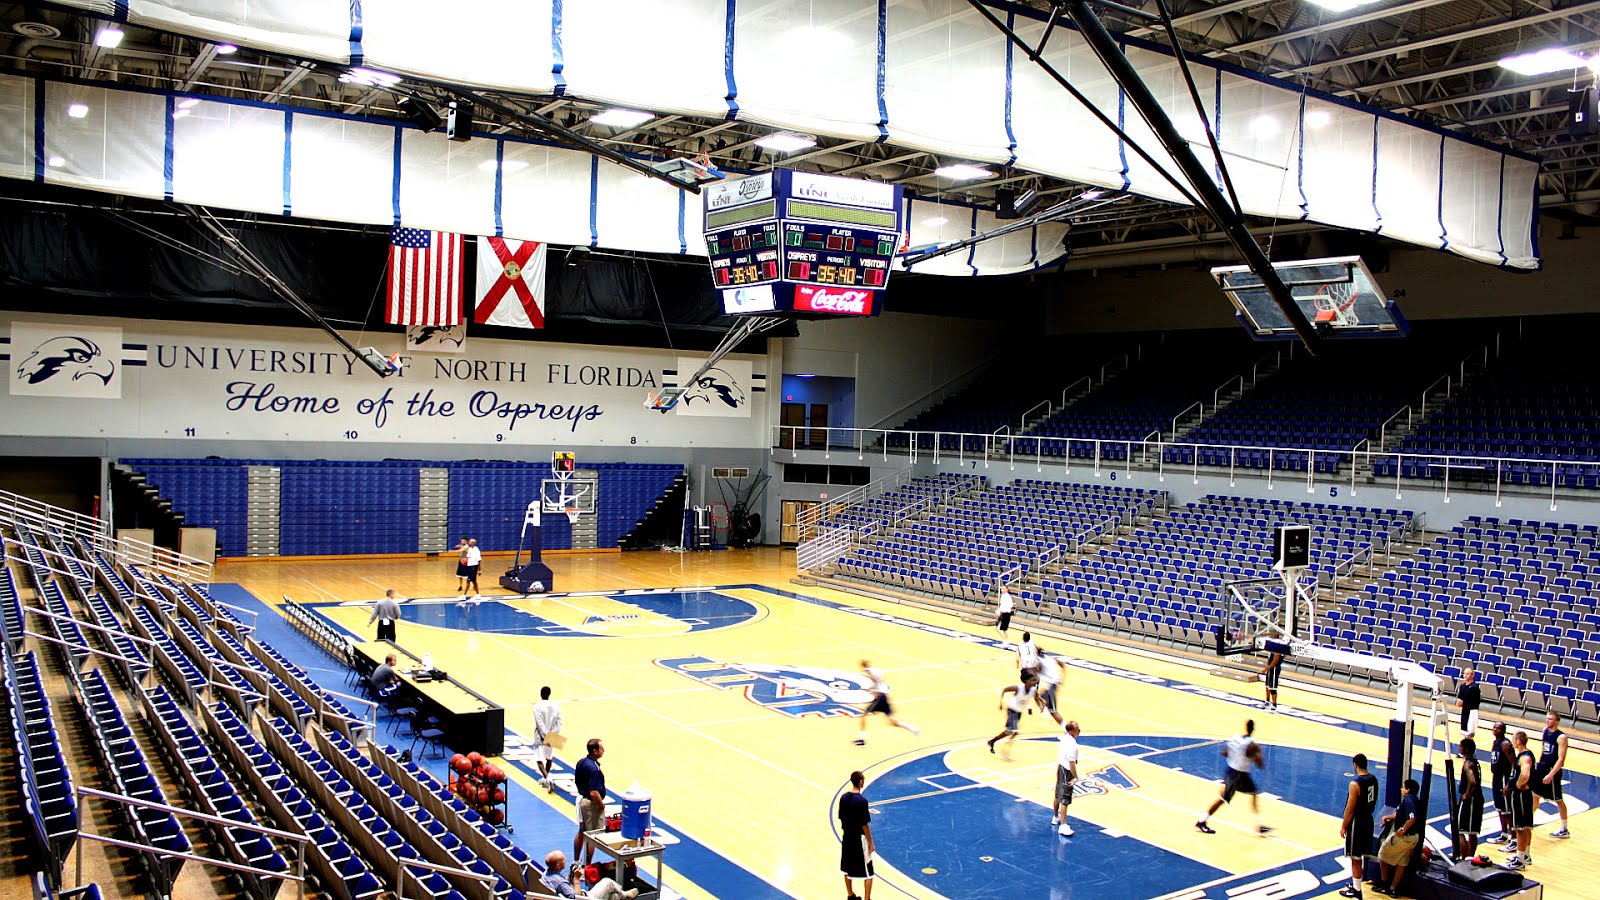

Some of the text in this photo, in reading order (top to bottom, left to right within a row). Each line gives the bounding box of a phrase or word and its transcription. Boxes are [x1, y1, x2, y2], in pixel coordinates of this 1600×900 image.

[786, 224, 805, 232] FOULS
[832, 229, 852, 237] PLAYER
[787, 251, 817, 262] OSPREYS
[860, 258, 886, 268] VISITOR
[817, 265, 856, 284] 35:40
[1393, 289, 1406, 298] 24
[156, 344, 358, 376] UNIVERSITY
[434, 358, 526, 383] NORTH
[548, 364, 657, 388] FLORIDA
[226, 381, 604, 431] Home of the Ospreys
[184, 427, 196, 437] 11
[345, 430, 358, 440] 10
[496, 434, 503, 443] 9
[630, 436, 637, 445] 8
[971, 461, 977, 470] 7
[1110, 472, 1117, 481] 6
[1329, 487, 1338, 497] 5
